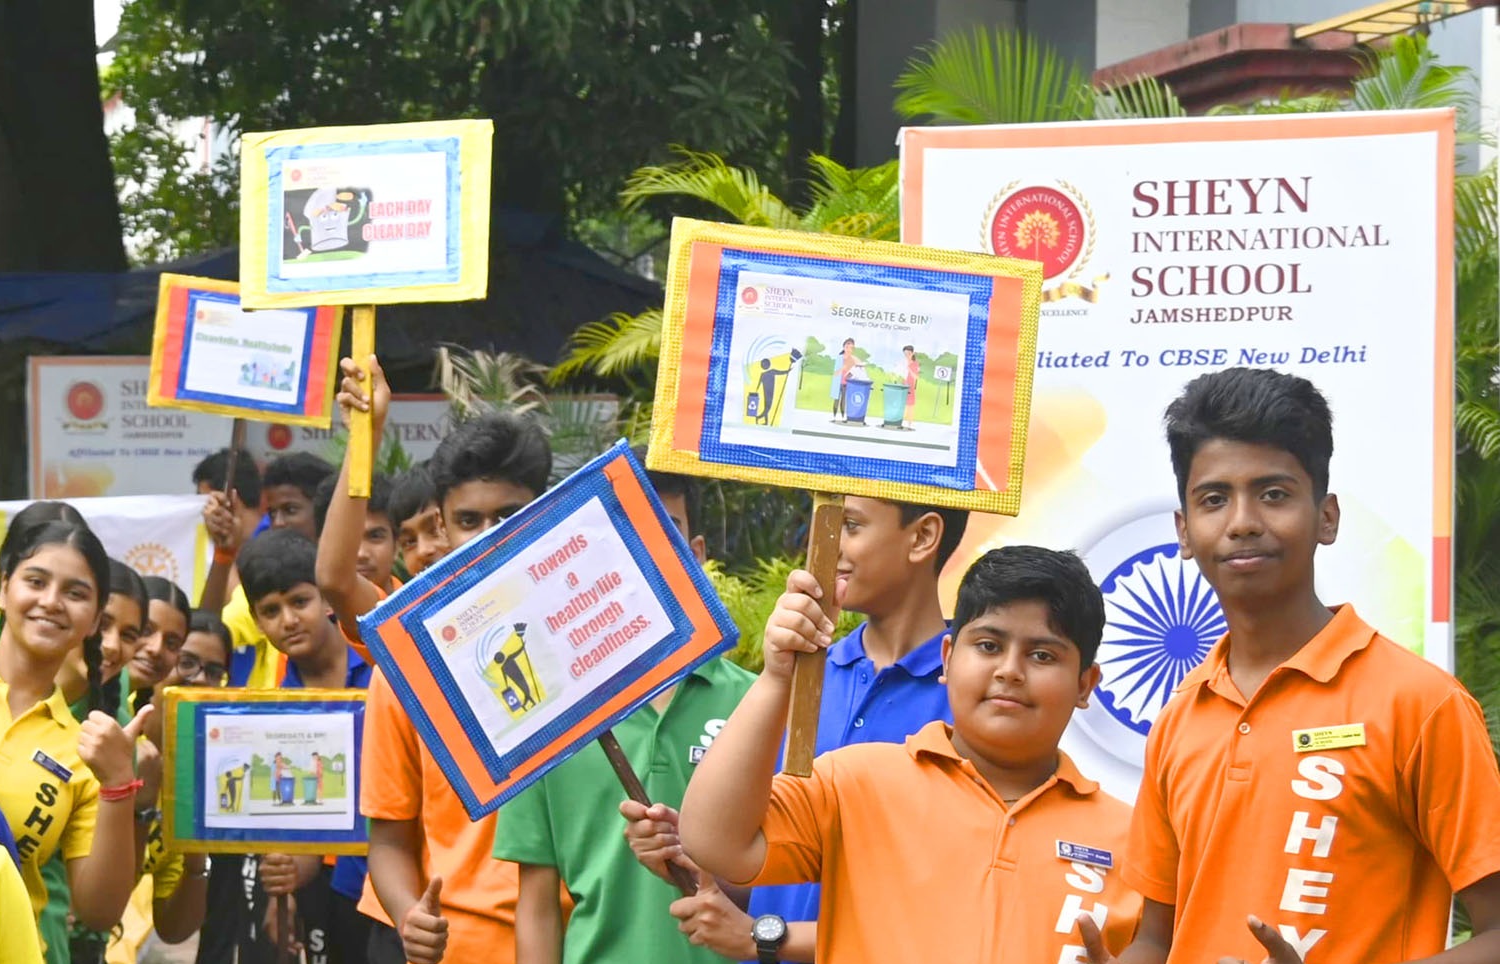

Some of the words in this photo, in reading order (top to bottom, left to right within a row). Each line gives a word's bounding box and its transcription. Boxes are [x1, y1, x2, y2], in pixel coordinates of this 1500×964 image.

[370, 202, 404, 217] EACH
[407, 199, 432, 215] DAY
[1131, 176, 1312, 219] SHEYN
[362, 223, 404, 241] CLEAN
[407, 220, 432, 238] DAY
[1131, 225, 1390, 254] INTERNATIONAL
[765, 287, 794, 296] SHEYN
[1130, 263, 1313, 298] SCHOOL
[831, 306, 896, 322] SEGREGATE
[898, 313, 906, 323] &
[1039, 308, 1089, 317] XCELLENCE
[1130, 305, 1294, 324] JAMSHEDPUR
[1037, 350, 1110, 368] liated
[1121, 350, 1150, 367] To
[1158, 349, 1228, 366] CBSE
[1237, 348, 1290, 365] New
[1299, 345, 1367, 364] Delhi
[122, 414, 191, 429] SCHOOL
[527, 534, 588, 582] Towards
[566, 571, 579, 587] a
[547, 587, 600, 633] healthy
[596, 571, 622, 596] life
[568, 600, 624, 647] through
[570, 614, 651, 678] cleanliness.
[16, 782, 59, 863] SHE
[1277, 755, 1346, 962] SHEY
